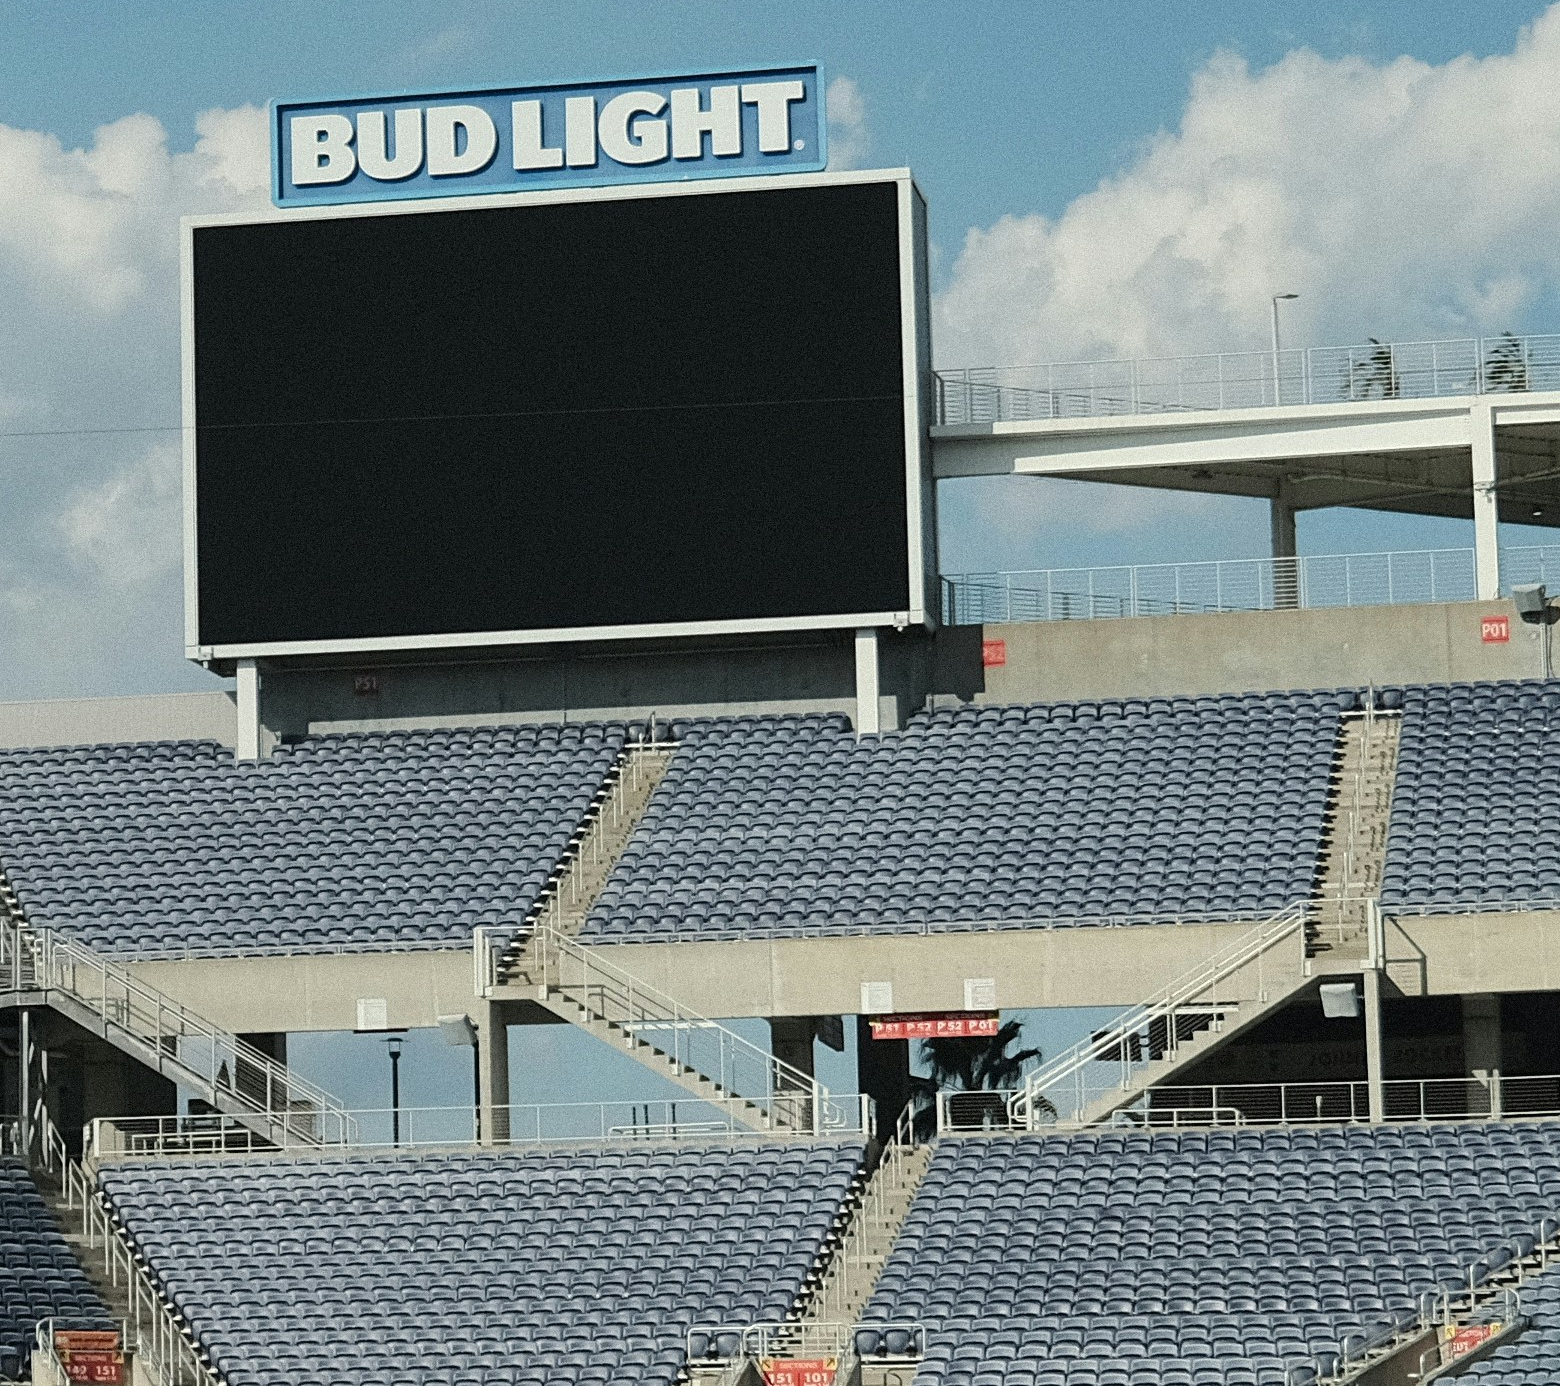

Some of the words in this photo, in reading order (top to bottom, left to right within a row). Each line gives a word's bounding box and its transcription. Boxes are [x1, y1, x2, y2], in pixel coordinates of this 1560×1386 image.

[290, 104, 498, 186] BUD
[511, 80, 805, 171] LIGHT
[1482, 622, 1506, 638] P01
[95, 1365, 116, 1376] 151
[768, 1372, 793, 1384] 151
[803, 1372, 828, 1383] 101
